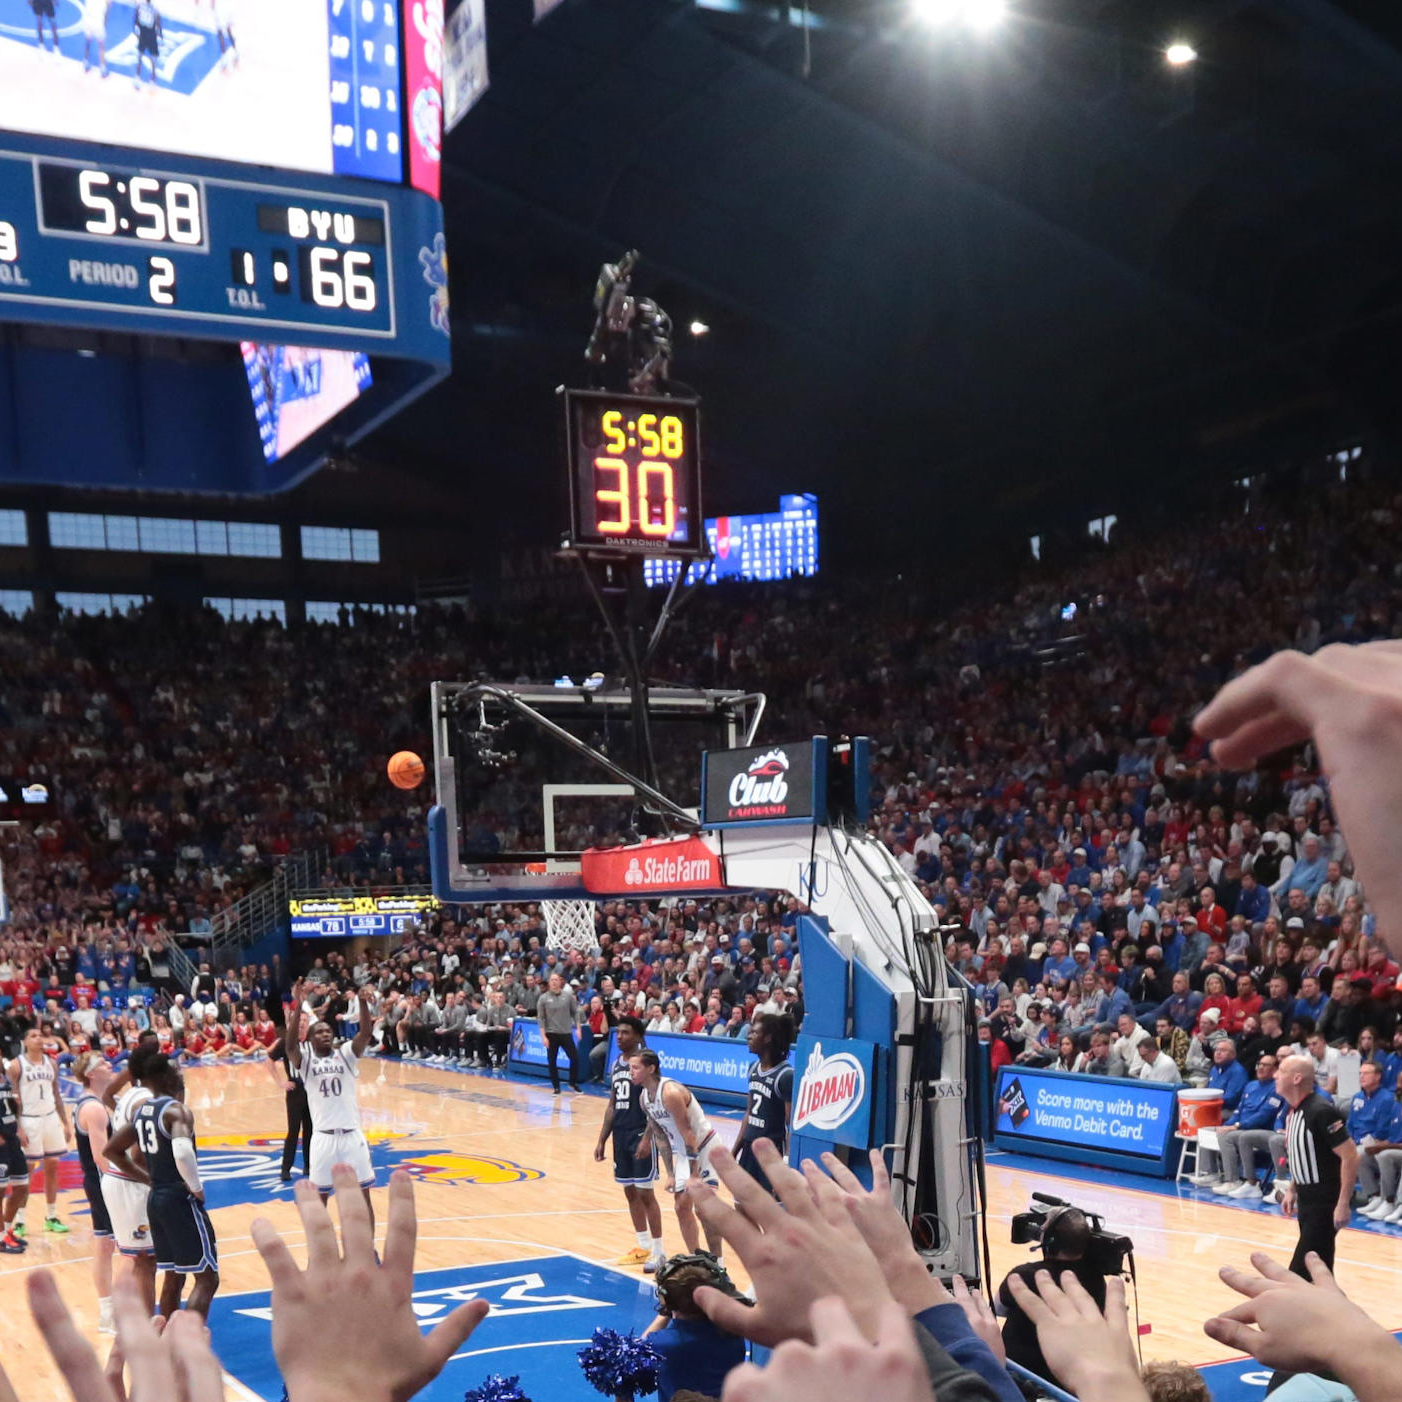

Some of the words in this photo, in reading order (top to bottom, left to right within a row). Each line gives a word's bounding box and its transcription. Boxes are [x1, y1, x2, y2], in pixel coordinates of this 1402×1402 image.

[79, 170, 201, 245] 5:58
[288, 207, 355, 244] BYU
[69, 259, 139, 289] PERIOD
[149, 256, 175, 304] 2
[243, 252, 255, 285] 1
[310, 247, 376, 311] 66
[602, 411, 683, 458] 5:58
[595, 458, 674, 535] 30
[605, 537, 669, 549] DAKTRONICS
[729, 772, 788, 806] Club
[798, 861, 830, 903] KU
[291, 922, 320, 932] KANSAS
[658, 1050, 685, 1071] Score
[686, 1056, 713, 1073] more
[714, 1059, 737, 1076] with
[39, 1084, 44, 1100] 1
[319, 1077, 342, 1098] 40
[614, 1080, 630, 1100] 30
[798, 1069, 858, 1121] LIBMAN
[1037, 1088, 1072, 1109] Score
[1073, 1096, 1105, 1113] more
[1106, 1100, 1134, 1117] with
[1136, 1102, 1159, 1121] the
[135, 1119, 158, 1154] 13
[1035, 1109, 1072, 1130] Venmo
[1073, 1114, 1108, 1134] Debit
[1110, 1118, 1144, 1141] Card.
